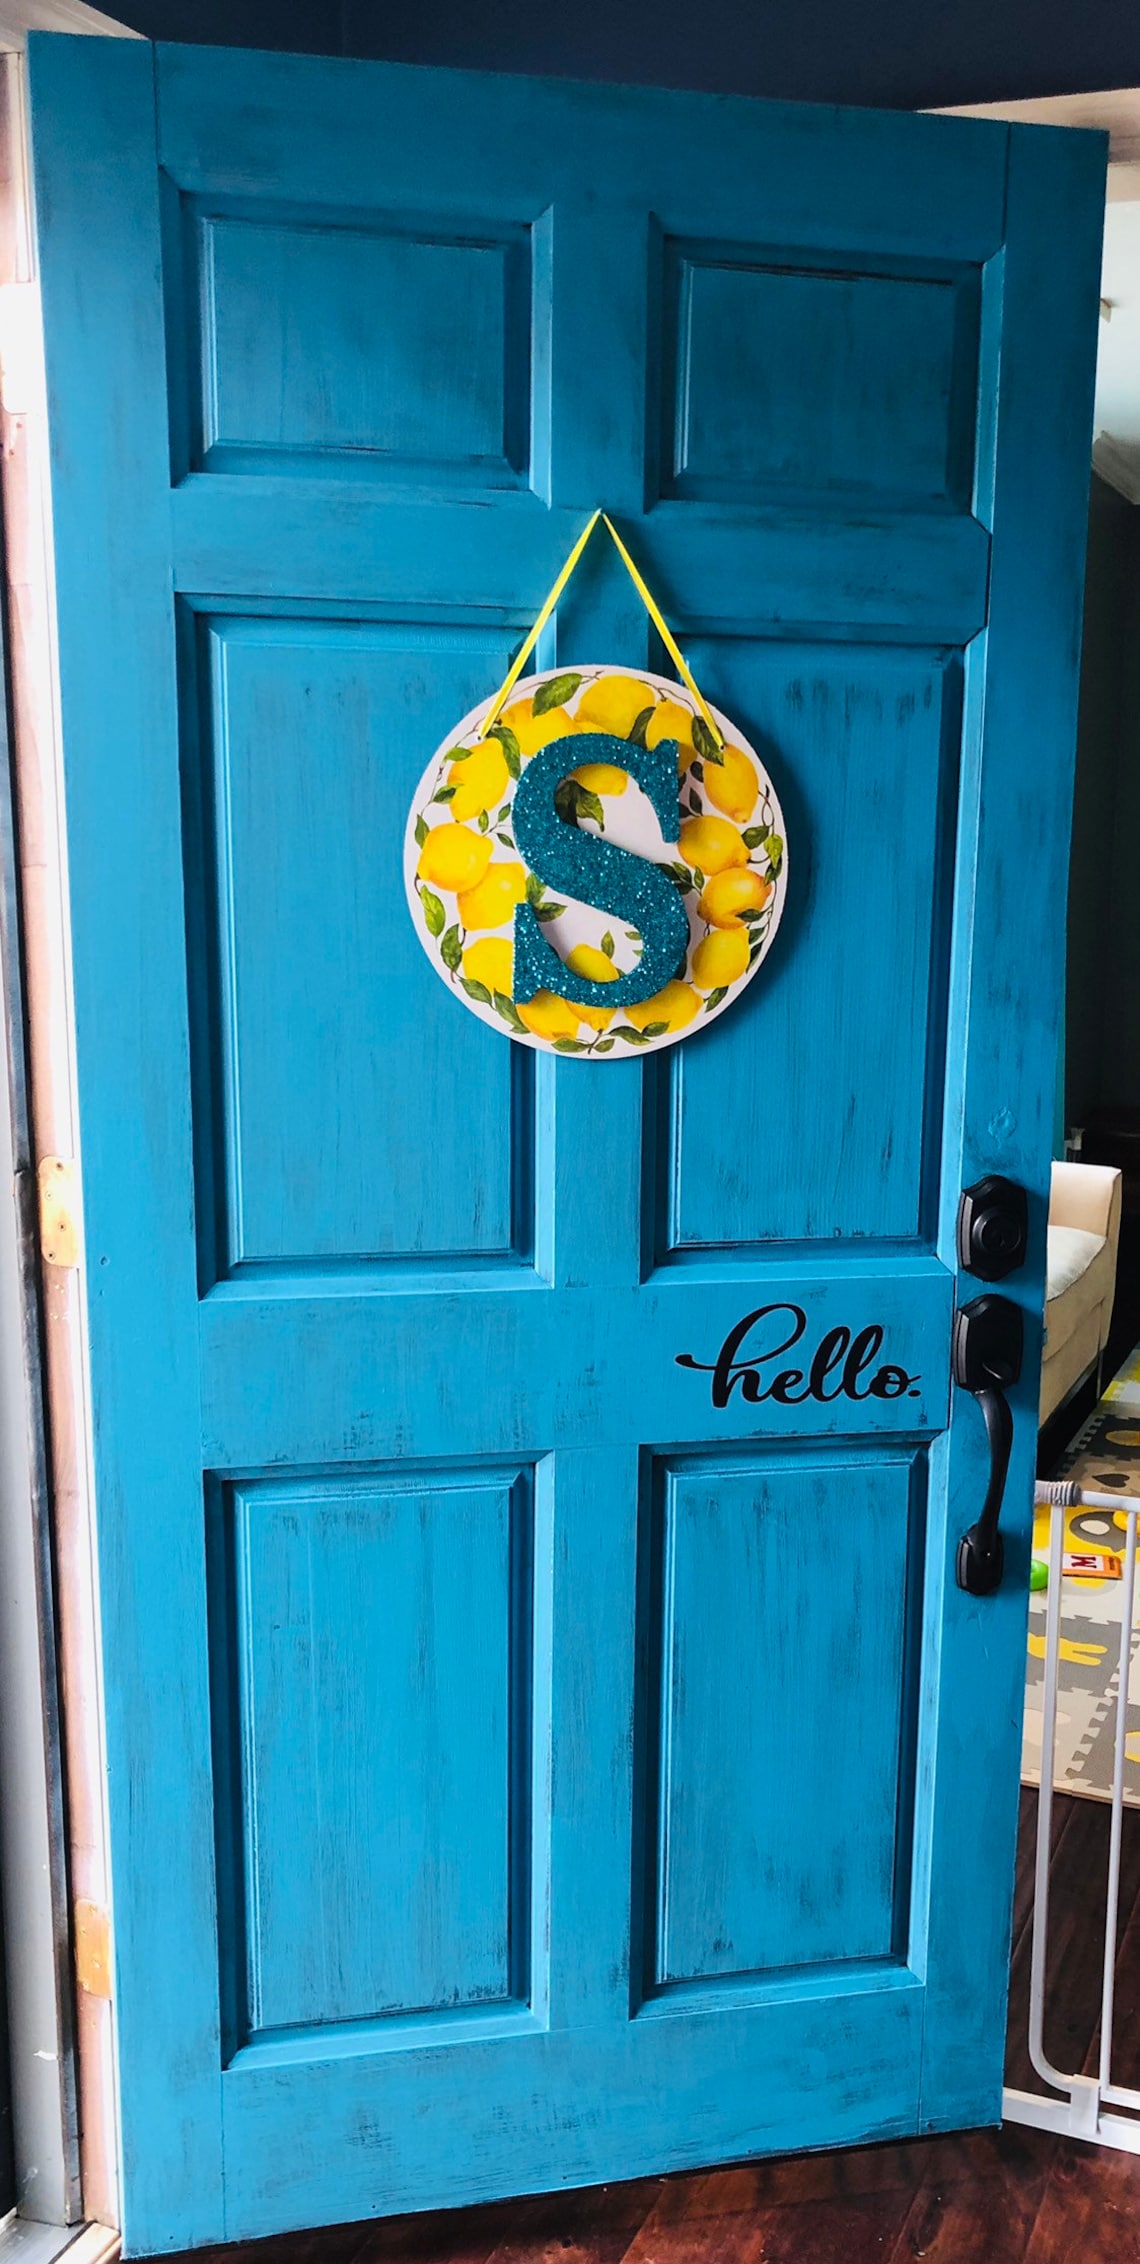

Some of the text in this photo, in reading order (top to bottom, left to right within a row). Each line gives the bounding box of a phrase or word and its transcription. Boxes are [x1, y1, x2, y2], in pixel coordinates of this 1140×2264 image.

[512, 732, 690, 1008] S
[675, 1303, 922, 1408] hello.
[1071, 1555, 1097, 1569] M
